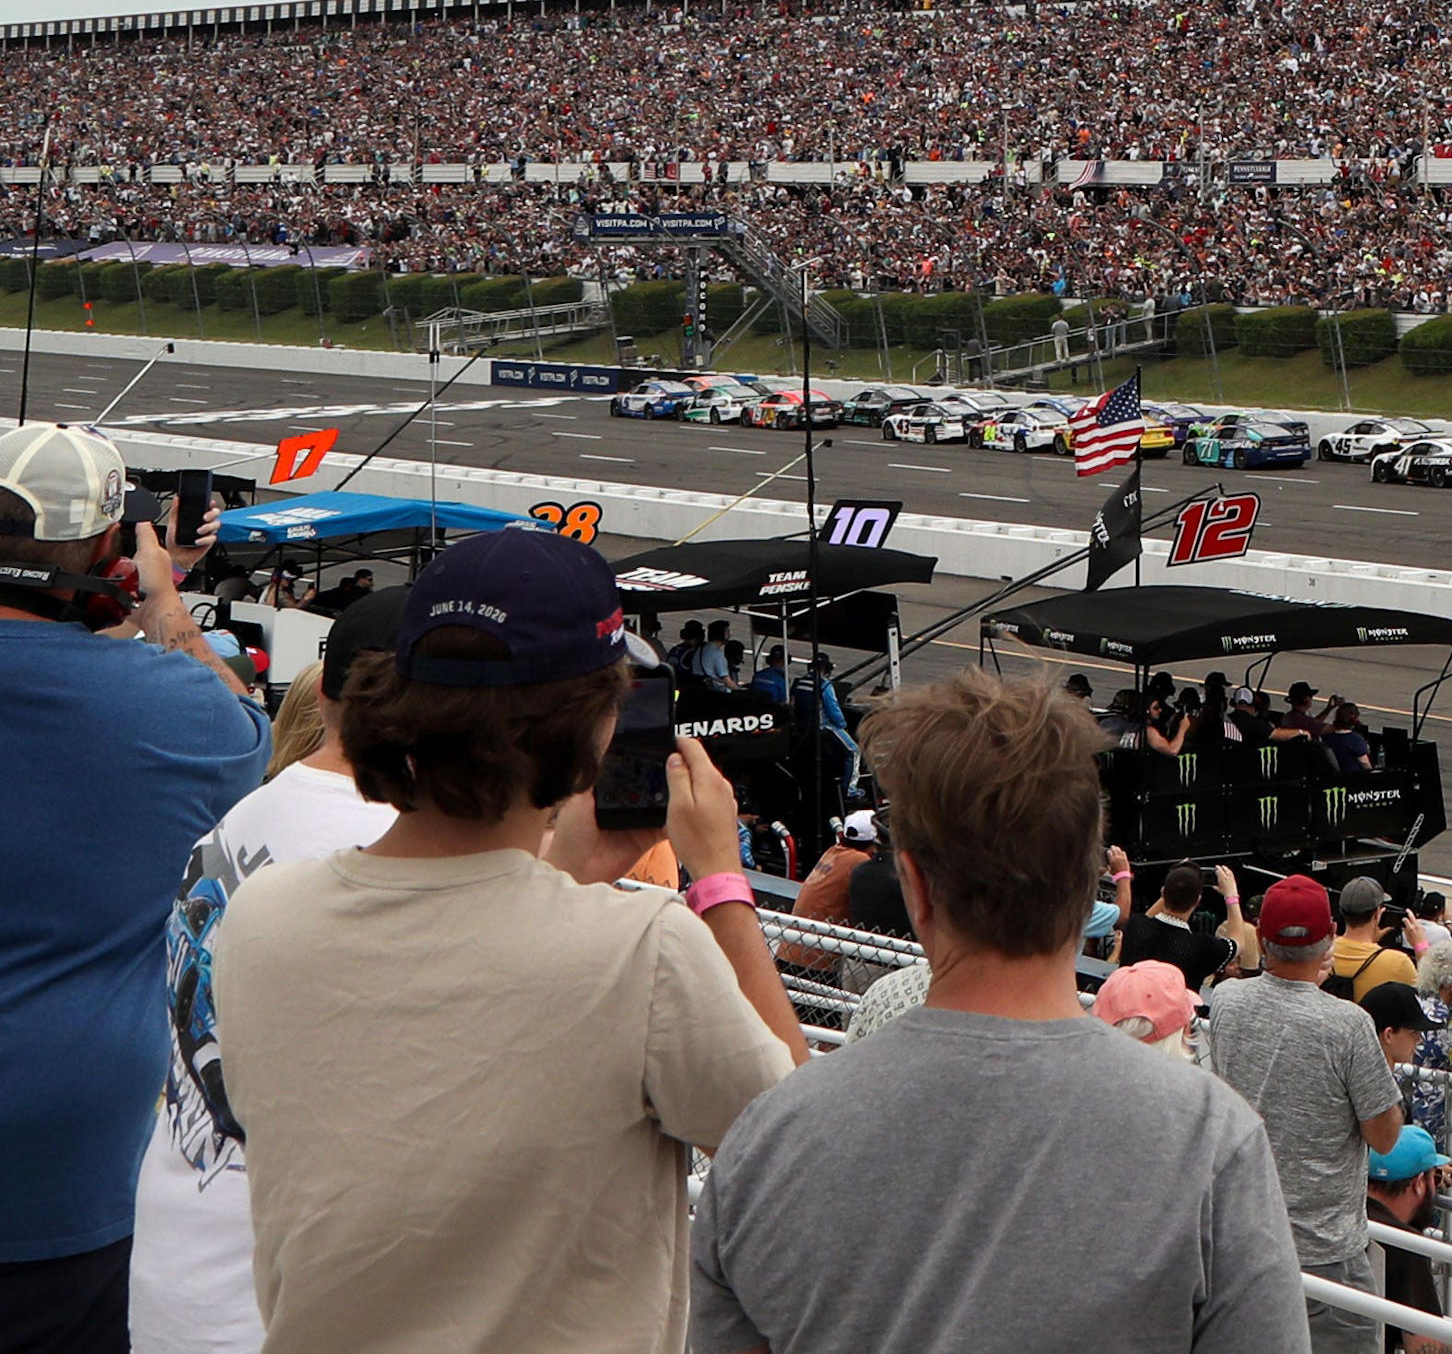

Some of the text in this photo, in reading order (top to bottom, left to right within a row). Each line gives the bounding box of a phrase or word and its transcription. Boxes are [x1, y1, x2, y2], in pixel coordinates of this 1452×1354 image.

[596, 219, 647, 227] VISITPA.COM
[663, 220, 712, 228] VISITPA.COM
[983, 424, 996, 441] 24
[1200, 441, 1213, 459] 71
[1335, 437, 1352, 455] 45
[269, 426, 340, 485] 17
[1394, 455, 1411, 475] 41
[828, 506, 891, 547] 10
[1170, 493, 1260, 566] 12
[616, 566, 710, 588] TEAM
[768, 570, 808, 584] TEAM
[758, 581, 812, 596] PENSKE
[429, 600, 456, 618] JUNE
[1233, 633, 1277, 645] MONSTER
[1368, 627, 1409, 638] MONSTER
[675, 713, 774, 738] ENARDS
[1347, 789, 1401, 803] MONSTER
